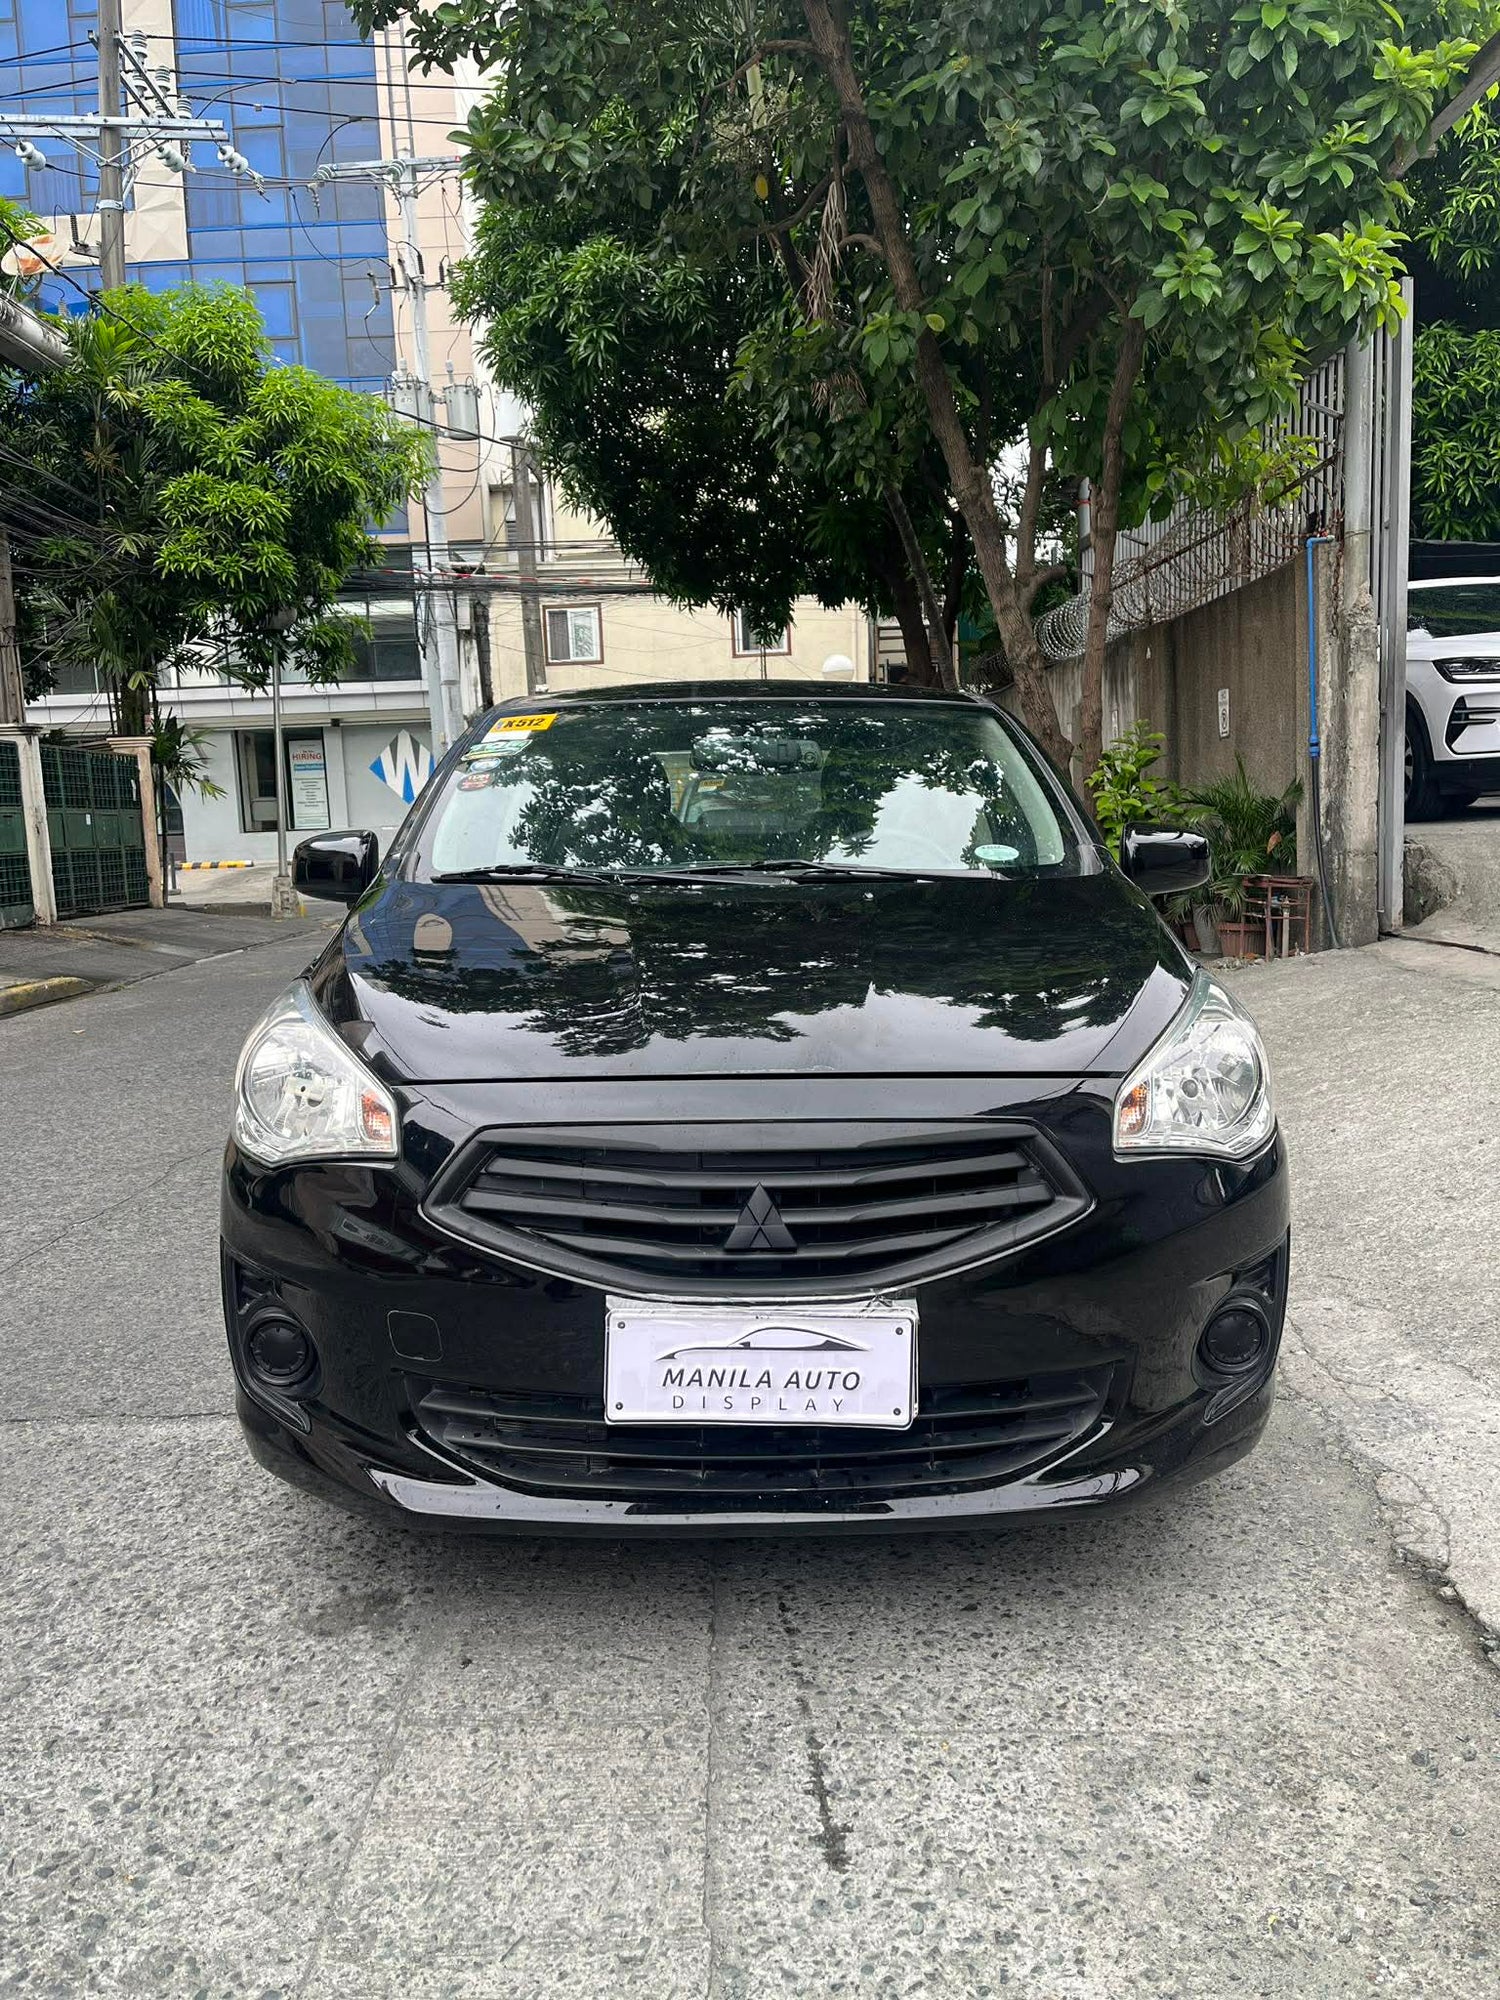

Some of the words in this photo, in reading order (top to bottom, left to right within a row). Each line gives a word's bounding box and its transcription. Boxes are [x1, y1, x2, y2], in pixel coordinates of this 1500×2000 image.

[292, 752, 322, 761] HIRING
[661, 1367, 772, 1389] MANILA
[783, 1370, 861, 1391] AUTO
[672, 1394, 845, 1412] DISPLAY
